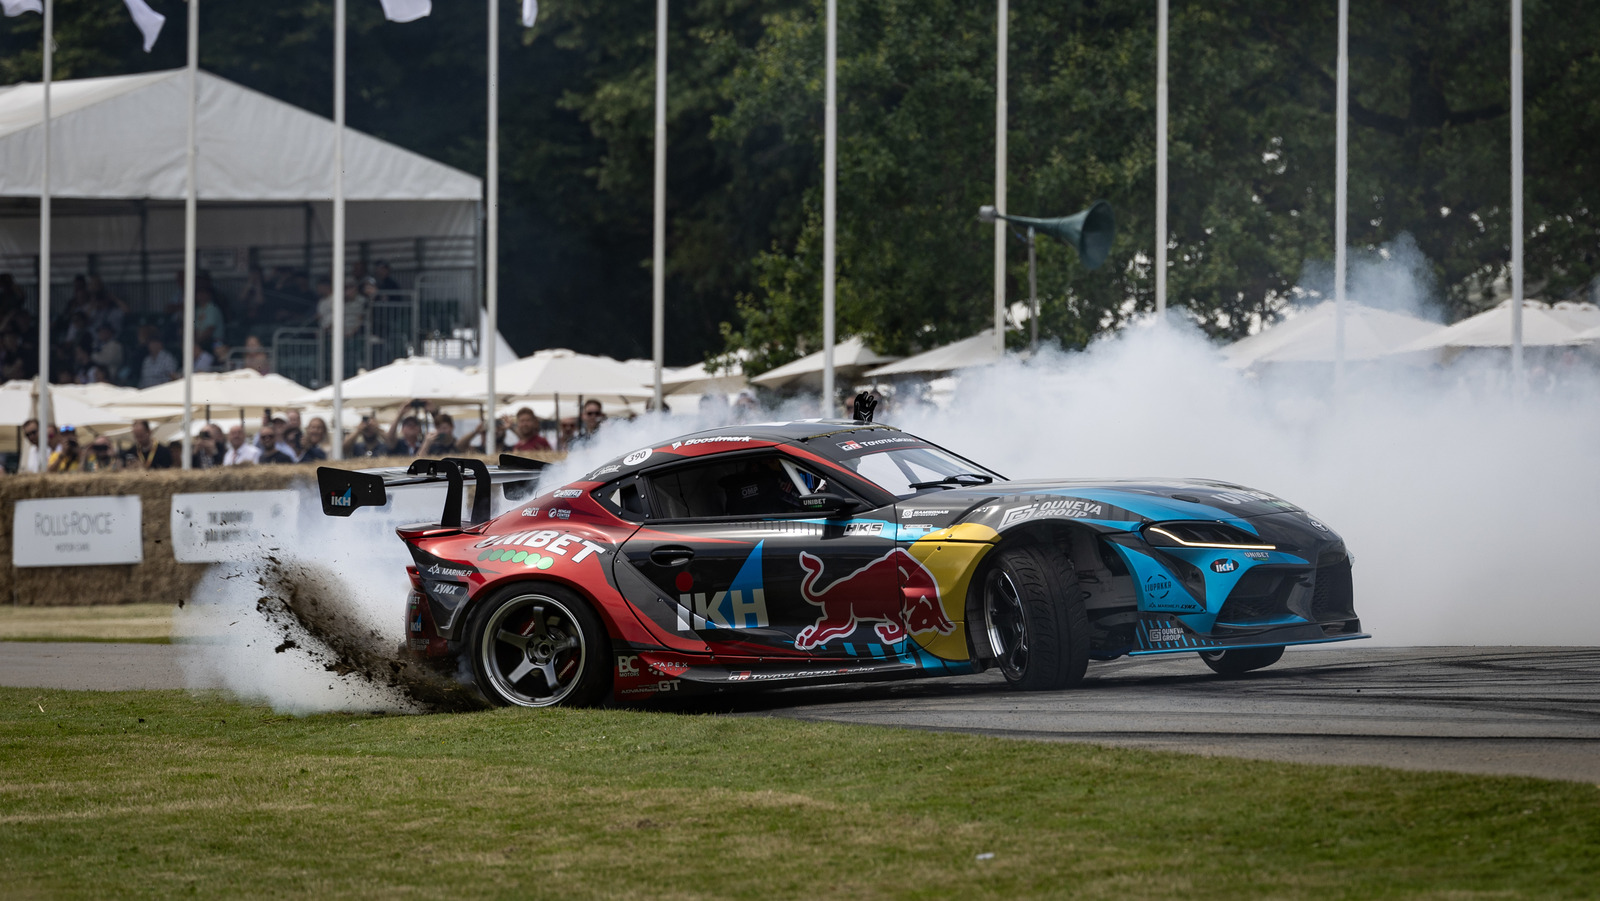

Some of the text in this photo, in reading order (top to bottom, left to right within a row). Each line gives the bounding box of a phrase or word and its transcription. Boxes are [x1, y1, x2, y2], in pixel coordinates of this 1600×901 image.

[684, 436, 752, 446] Boostmark
[860, 438, 893, 447] TOYOTA
[628, 451, 647, 463] 390
[741, 486, 759, 496] OMP
[803, 498, 826, 506] UNIBET
[1039, 500, 1102, 516] OUNEVA
[1034, 509, 1088, 518] GROUP
[34, 510, 113, 537] ROLLS-ROYCE
[844, 523, 883, 533] HKS
[474, 530, 606, 564] UNIBET
[433, 583, 459, 595] LYNX
[1161, 627, 1185, 635] OUNEVA
[1162, 634, 1182, 642] GROUP
[617, 655, 640, 673] BC
[751, 672, 795, 681] TOYOTA
[657, 679, 681, 692] GT
